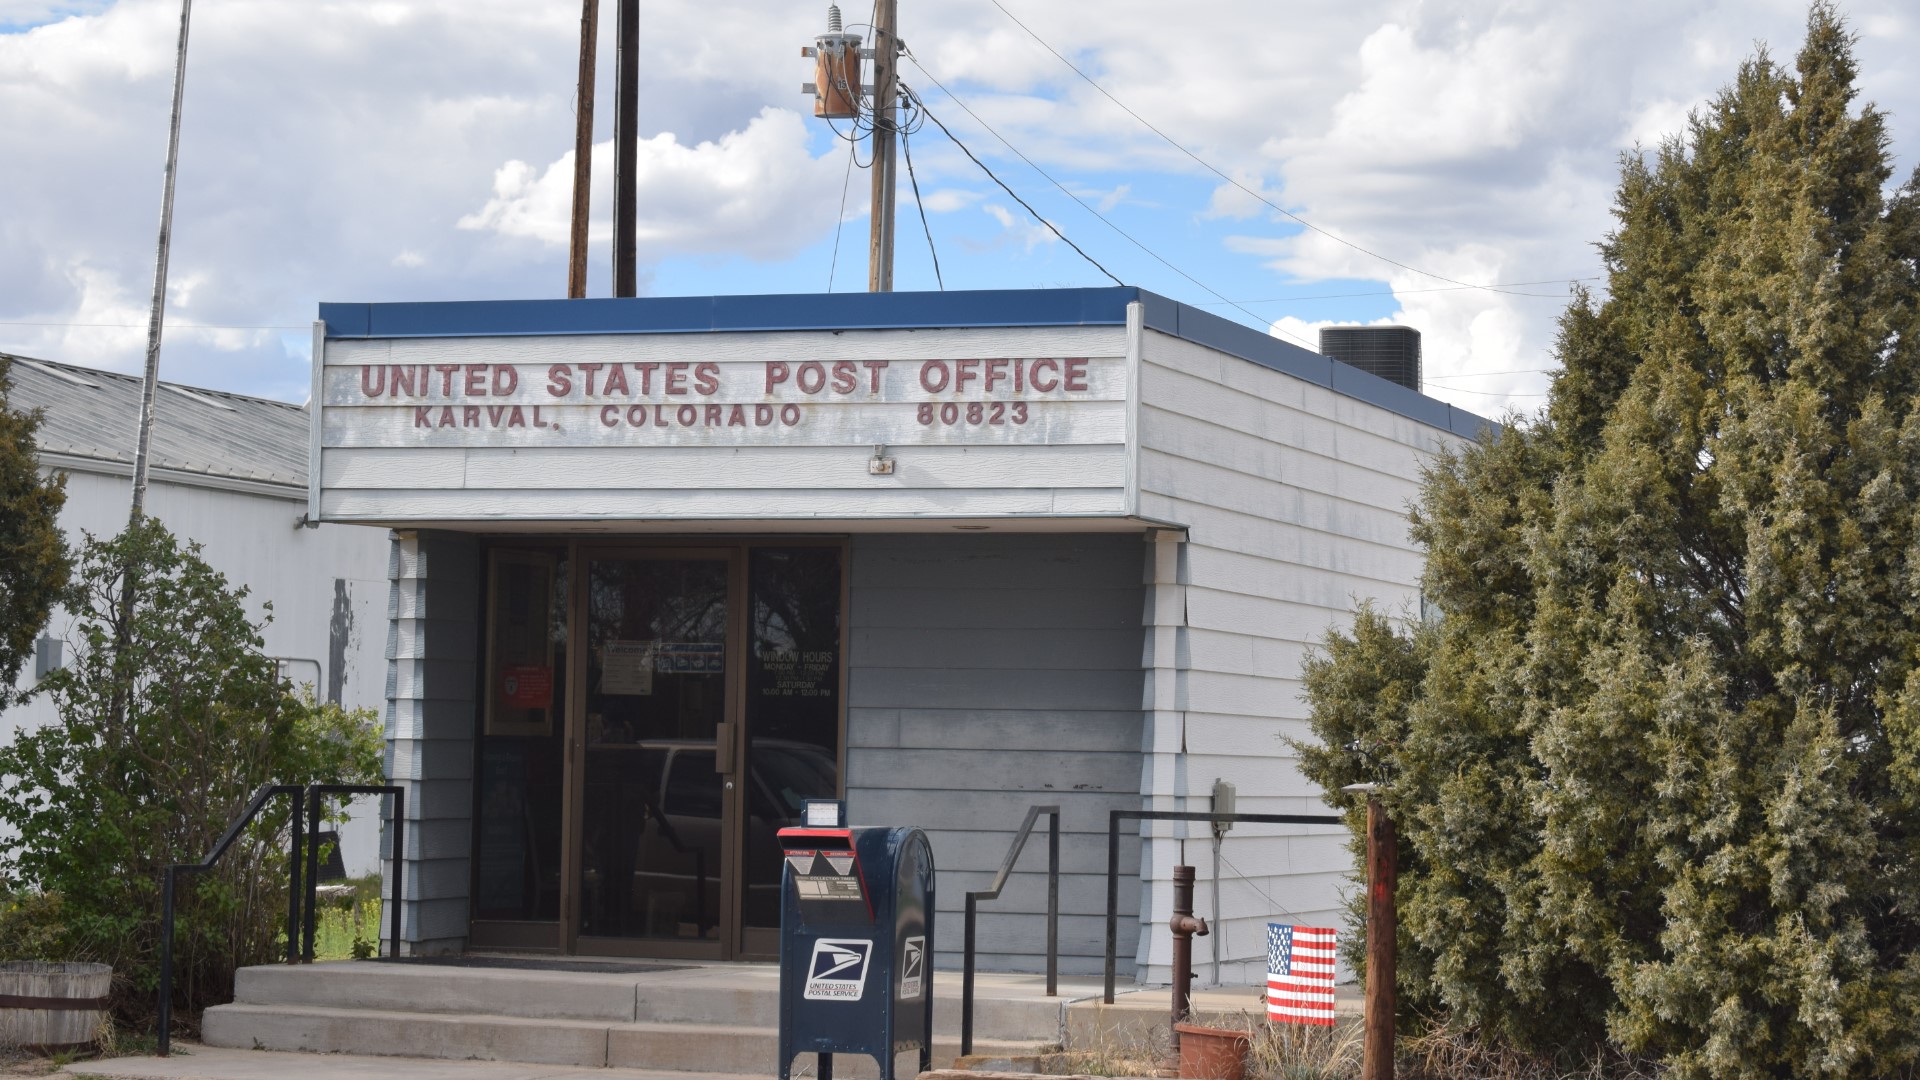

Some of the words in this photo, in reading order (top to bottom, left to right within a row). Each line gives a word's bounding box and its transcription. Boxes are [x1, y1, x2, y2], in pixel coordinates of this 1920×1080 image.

[361, 363, 519, 398] UNITED
[546, 361, 720, 398] STATES
[765, 360, 890, 395] POST
[919, 358, 1089, 394] OFFICE
[414, 405, 561, 431] KARVAL,
[600, 403, 800, 428] COLORADO
[917, 401, 1029, 426] 80823
[762, 651, 799, 663] WINDOW
[802, 651, 833, 663] HOURS
[763, 662, 795, 671] MONDAY
[804, 663, 830, 672] FRIDAY
[776, 681, 816, 689] SATURDAY
[782, 688, 793, 696] AM
[820, 689, 831, 697] PM
